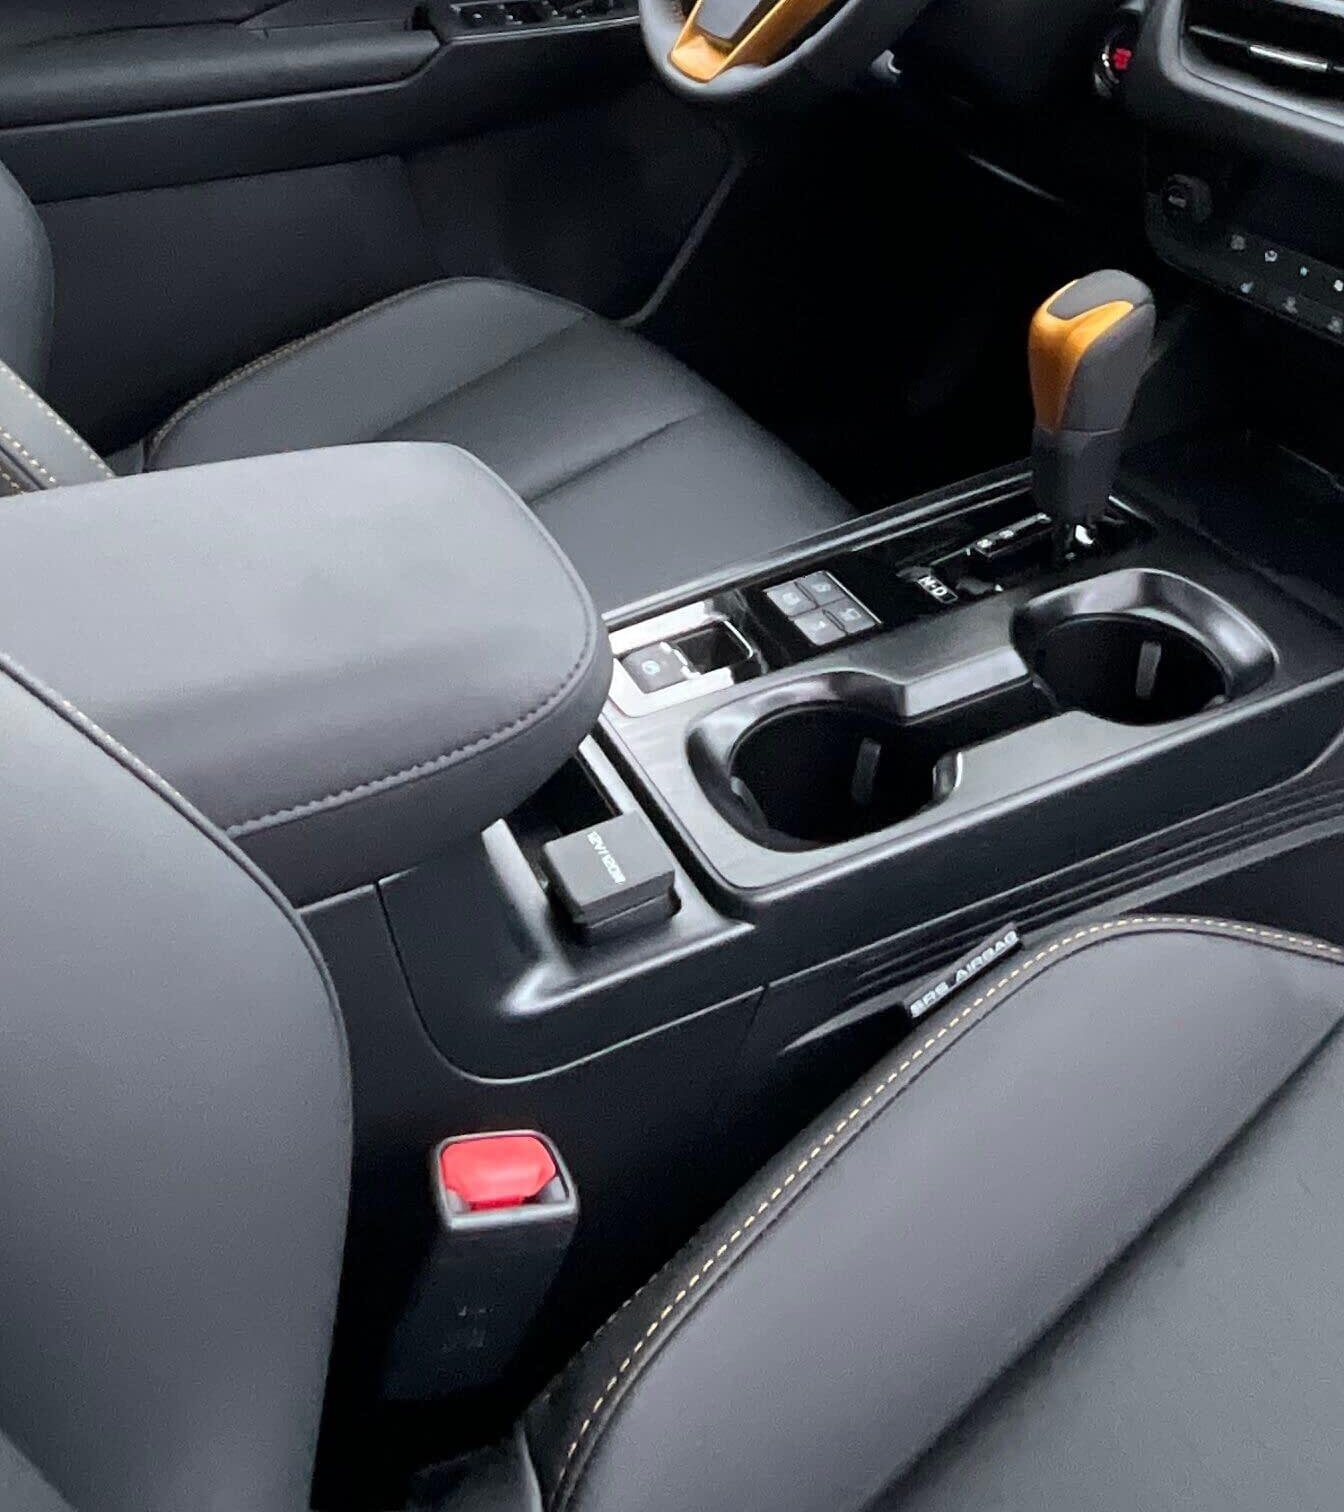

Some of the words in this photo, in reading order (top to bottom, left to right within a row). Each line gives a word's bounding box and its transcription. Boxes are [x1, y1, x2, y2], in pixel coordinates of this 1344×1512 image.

[587, 831, 626, 883] 12V/120W
[910, 981, 949, 1019] SRS
[955, 930, 1019, 984] AIRBAG
